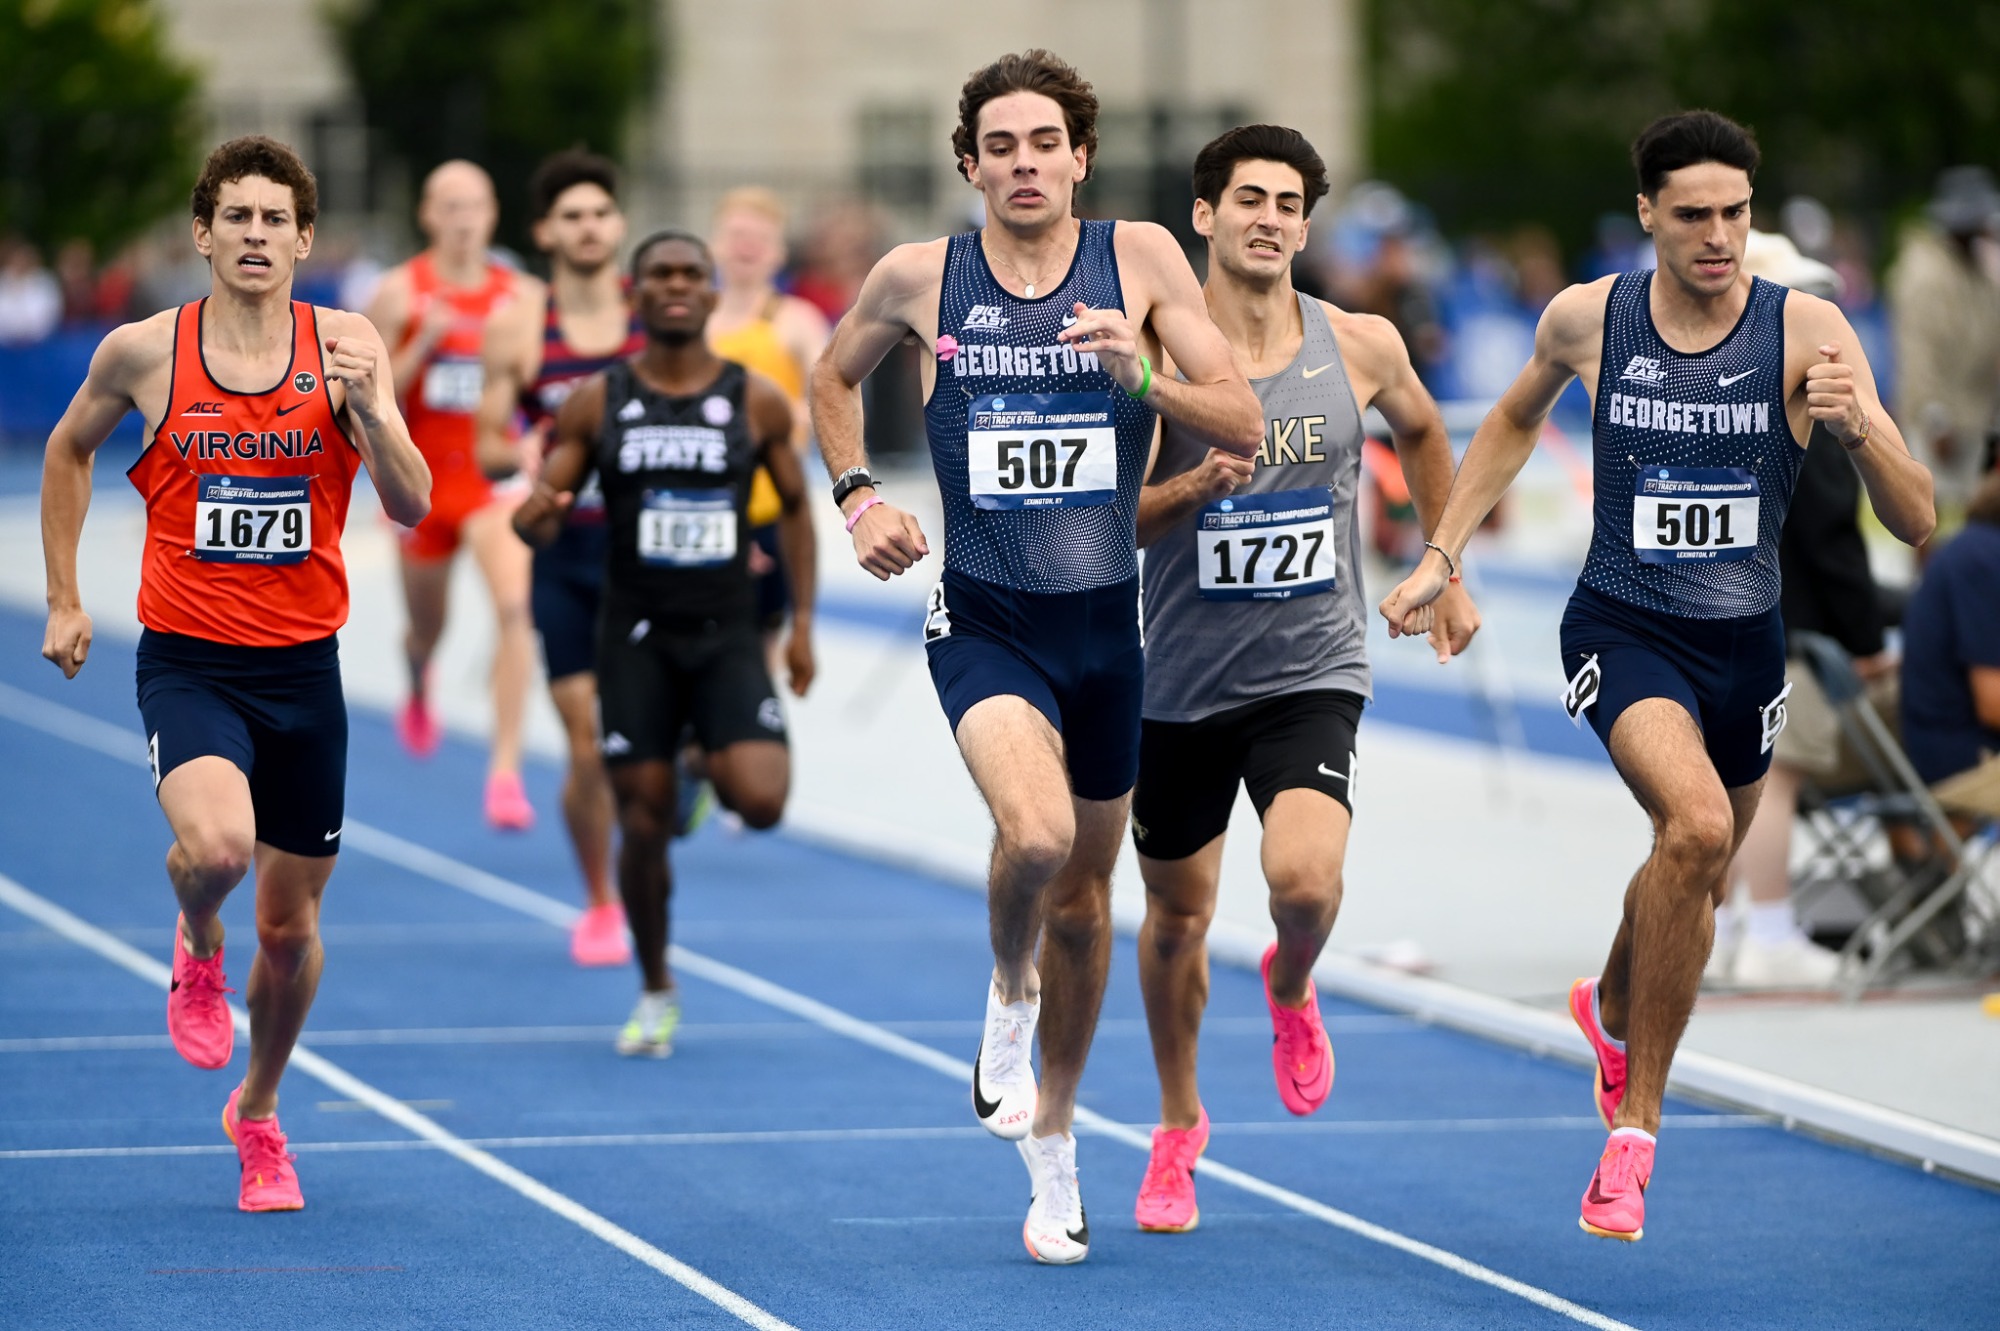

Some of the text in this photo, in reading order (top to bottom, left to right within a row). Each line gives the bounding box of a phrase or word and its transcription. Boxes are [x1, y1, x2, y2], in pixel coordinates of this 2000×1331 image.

[964, 314, 1011, 327] EAST
[969, 304, 1003, 317] BIG
[954, 341, 1099, 377] GEORGETOW
[1624, 365, 1668, 381] EAST
[1630, 354, 1661, 370] BIG
[185, 402, 225, 414] ACC
[992, 415, 1016, 424] TRACK
[1023, 414, 1044, 424] FIELD
[1045, 412, 1108, 424] CHAMPIONSHIPS
[1609, 393, 1769, 435] GEORGETOWN
[170, 427, 324, 460] VIRGINIA
[619, 440, 728, 473] STATE
[1255, 414, 1327, 467] AKE
[997, 438, 1088, 490] 507
[220, 489, 238, 497] TRACK
[260, 489, 305, 499] CHAMPIONSHIPS
[1658, 482, 1677, 491] TRACK
[1682, 483, 1700, 491] FIELD
[206, 508, 303, 549] 1679
[1220, 515, 1244, 525] TRACK
[1251, 513, 1271, 523] FIELD
[1272, 505, 1329, 521] CHAMPIONSHIPS
[1656, 503, 1734, 547] 501
[1213, 530, 1325, 584] 1727
[1566, 667, 1599, 719] 9
